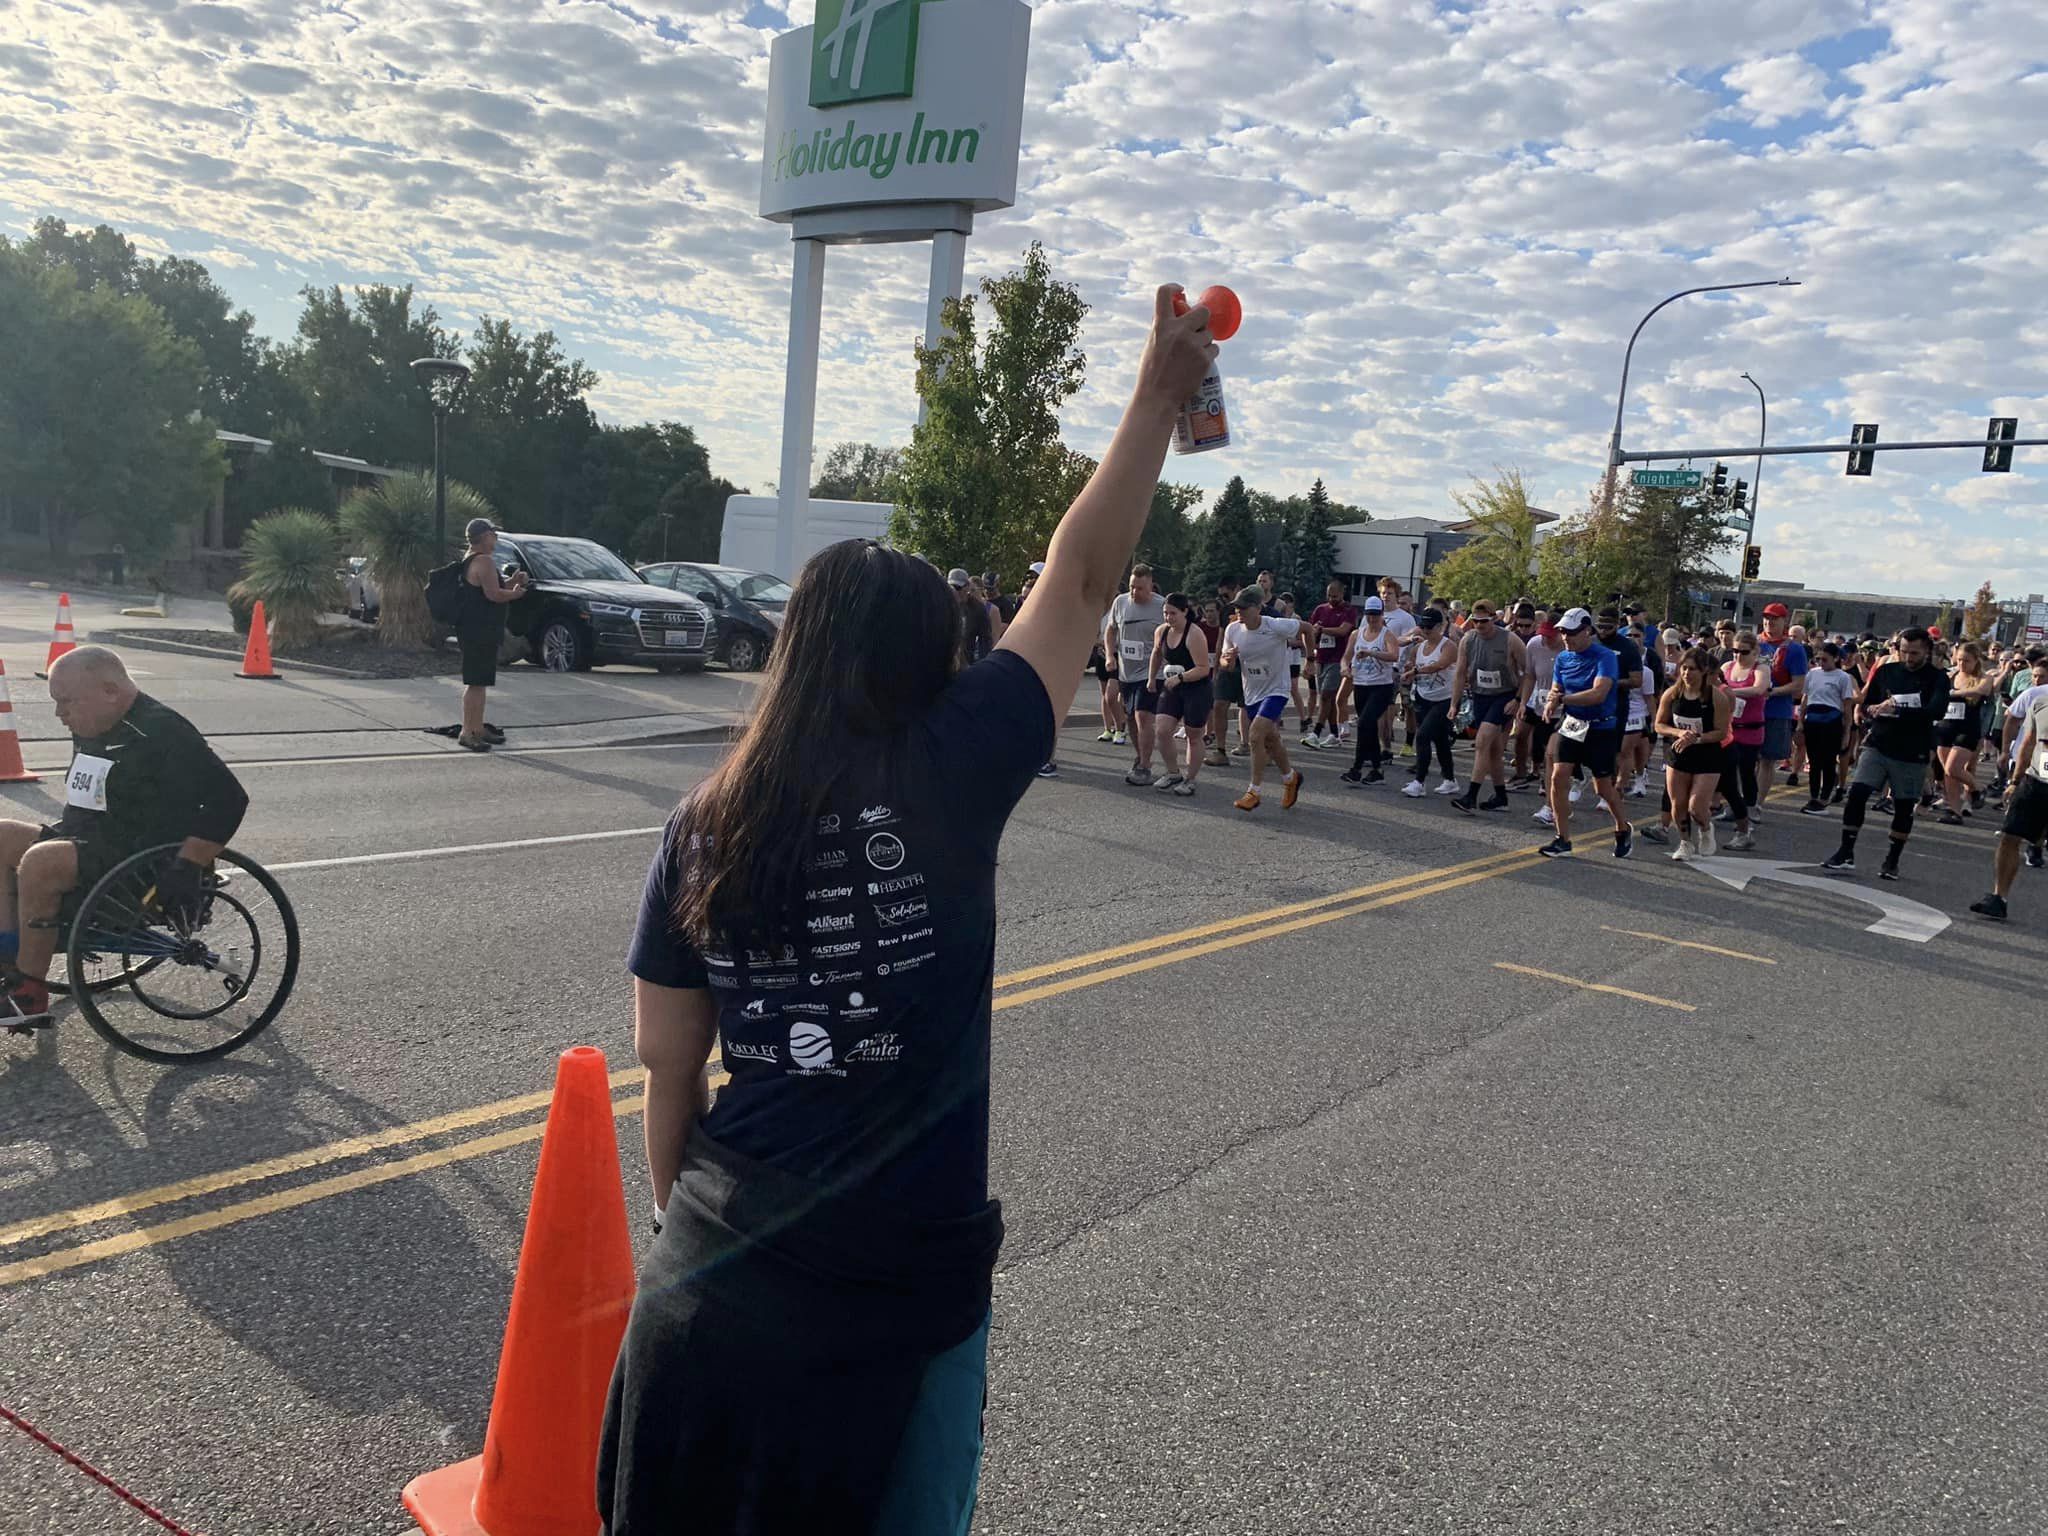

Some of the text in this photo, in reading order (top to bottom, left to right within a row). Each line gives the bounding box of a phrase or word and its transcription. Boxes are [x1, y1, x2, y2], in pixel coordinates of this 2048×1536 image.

[772, 111, 980, 181] Holiday Inn
[1633, 472, 1670, 486] Knight
[72, 771, 93, 792] 594
[857, 804, 892, 823] Apollo
[880, 873, 924, 894] HEALTH
[890, 902, 928, 919] Solutions
[814, 912, 855, 929] Alliant
[877, 926, 935, 949] Raw Family
[811, 940, 861, 955] FASTSIGNS
[727, 1040, 779, 1059] KADLEC
